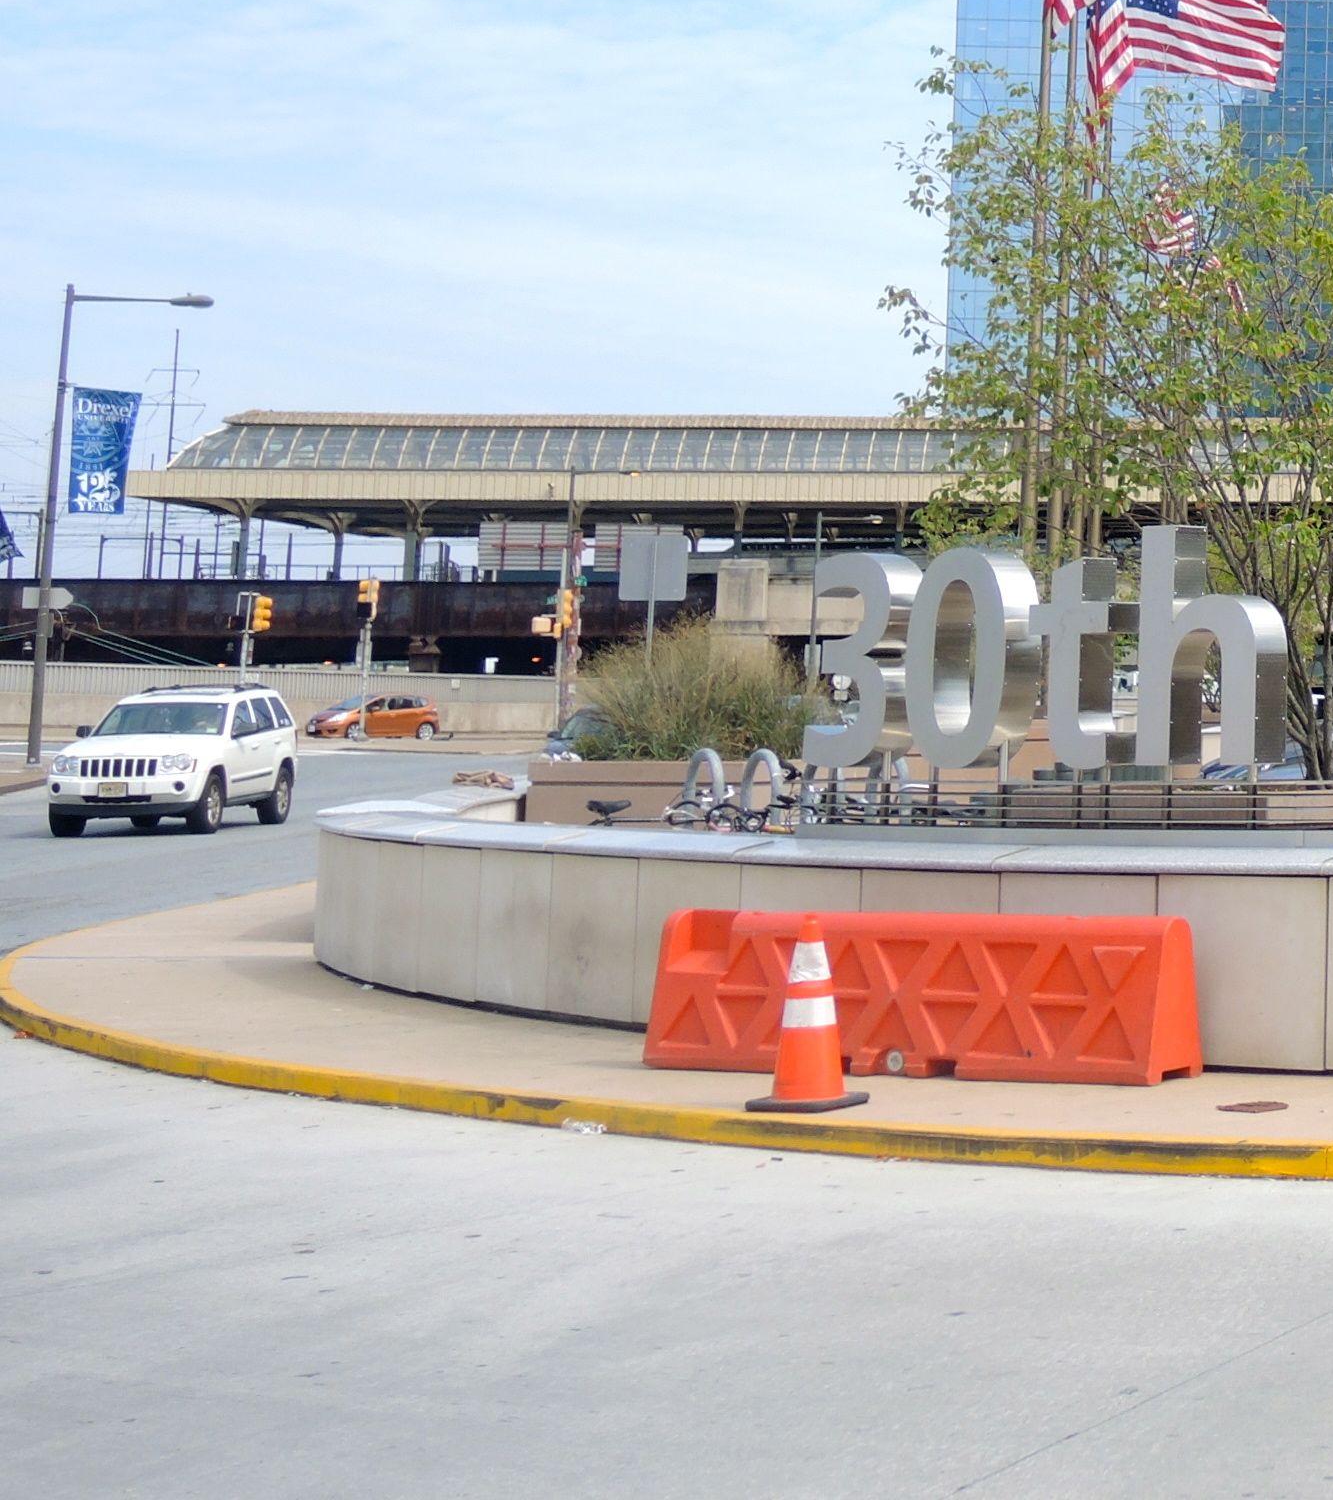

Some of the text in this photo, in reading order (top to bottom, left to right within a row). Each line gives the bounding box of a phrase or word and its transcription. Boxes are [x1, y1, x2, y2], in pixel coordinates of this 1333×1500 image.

[77, 397, 133, 418] Drexel
[75, 468, 121, 502] 125
[71, 494, 115, 512] YEARS
[802, 524, 1288, 769] 30th
